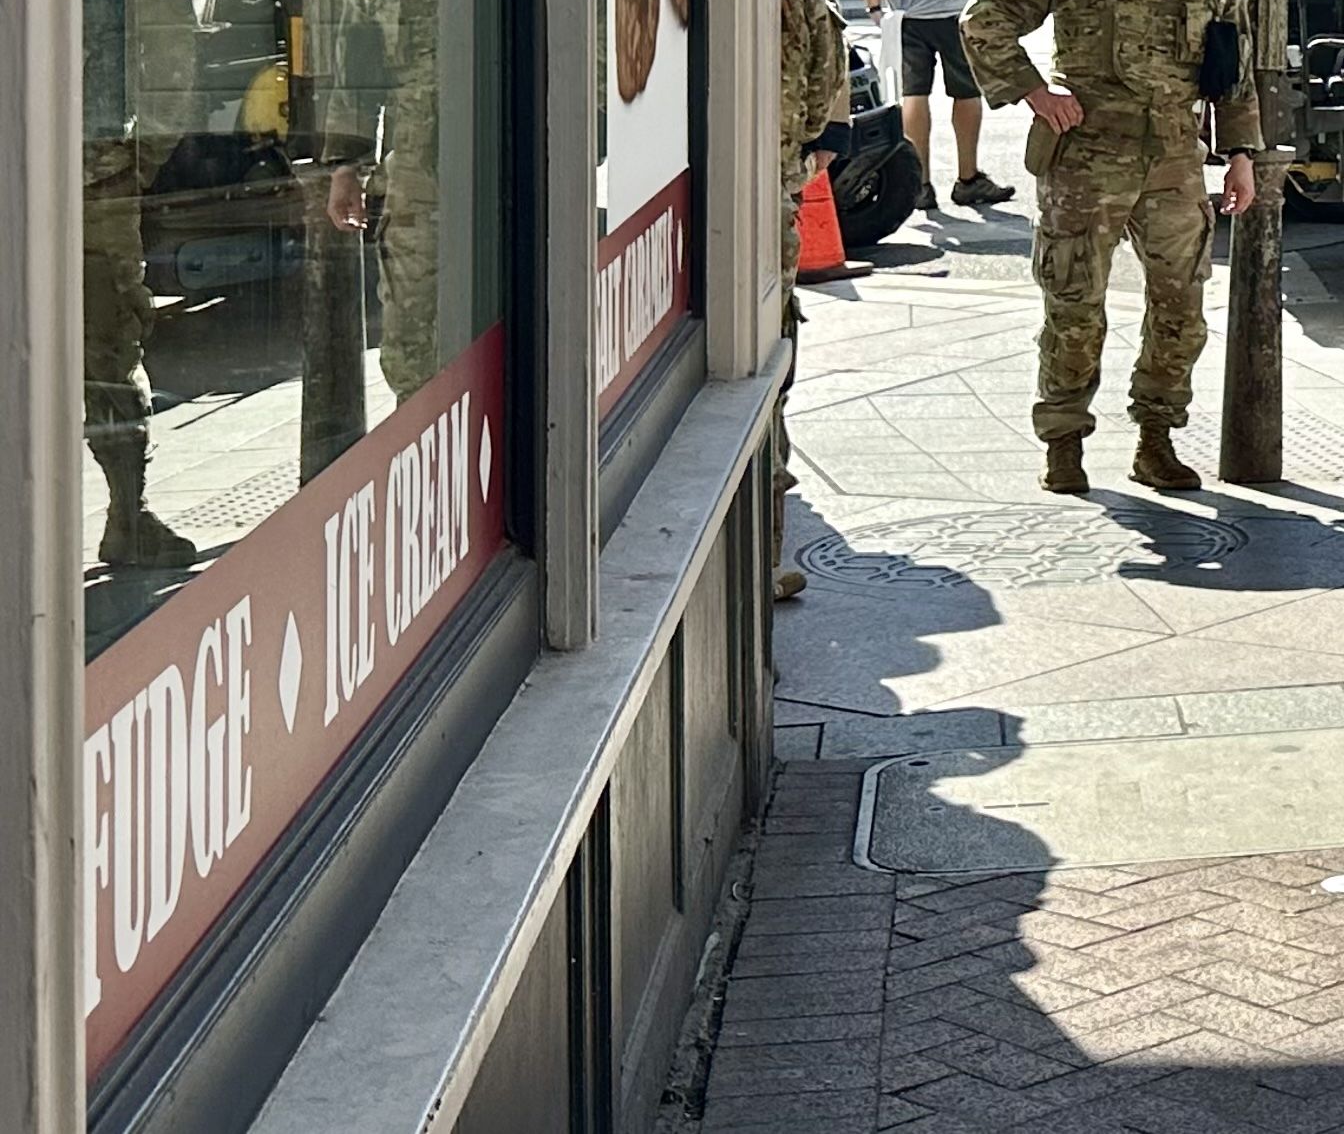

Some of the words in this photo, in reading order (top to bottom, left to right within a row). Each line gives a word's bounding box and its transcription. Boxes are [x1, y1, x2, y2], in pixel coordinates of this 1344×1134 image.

[85, 595, 253, 1019] FUDGE
[323, 480, 375, 728] ICE
[384, 391, 471, 647] CREAM
